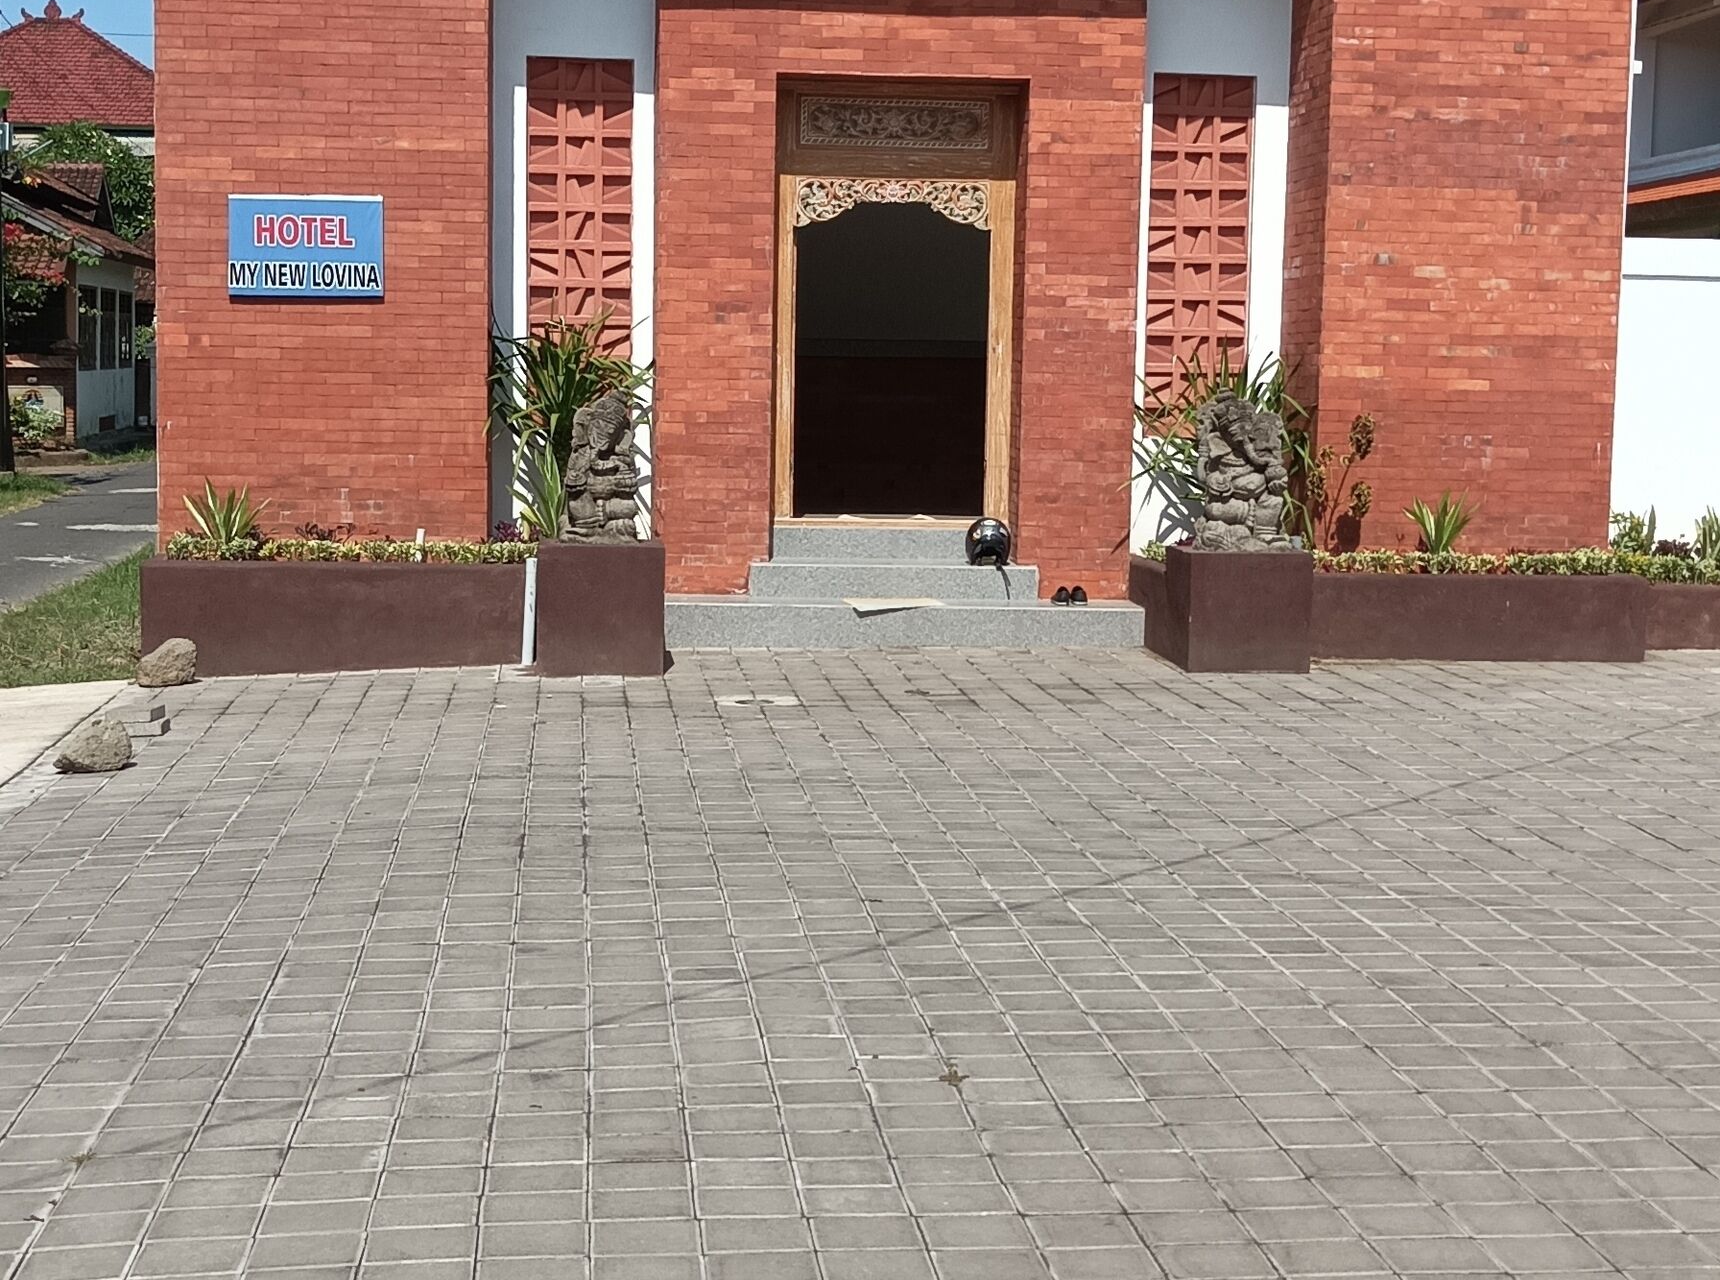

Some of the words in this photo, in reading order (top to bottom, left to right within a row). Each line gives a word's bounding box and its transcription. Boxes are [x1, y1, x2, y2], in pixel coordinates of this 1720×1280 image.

[255, 215, 354, 247] HOTEL
[229, 262, 258, 287] MY
[264, 263, 306, 288] NEW
[311, 264, 380, 289] LOVINA
